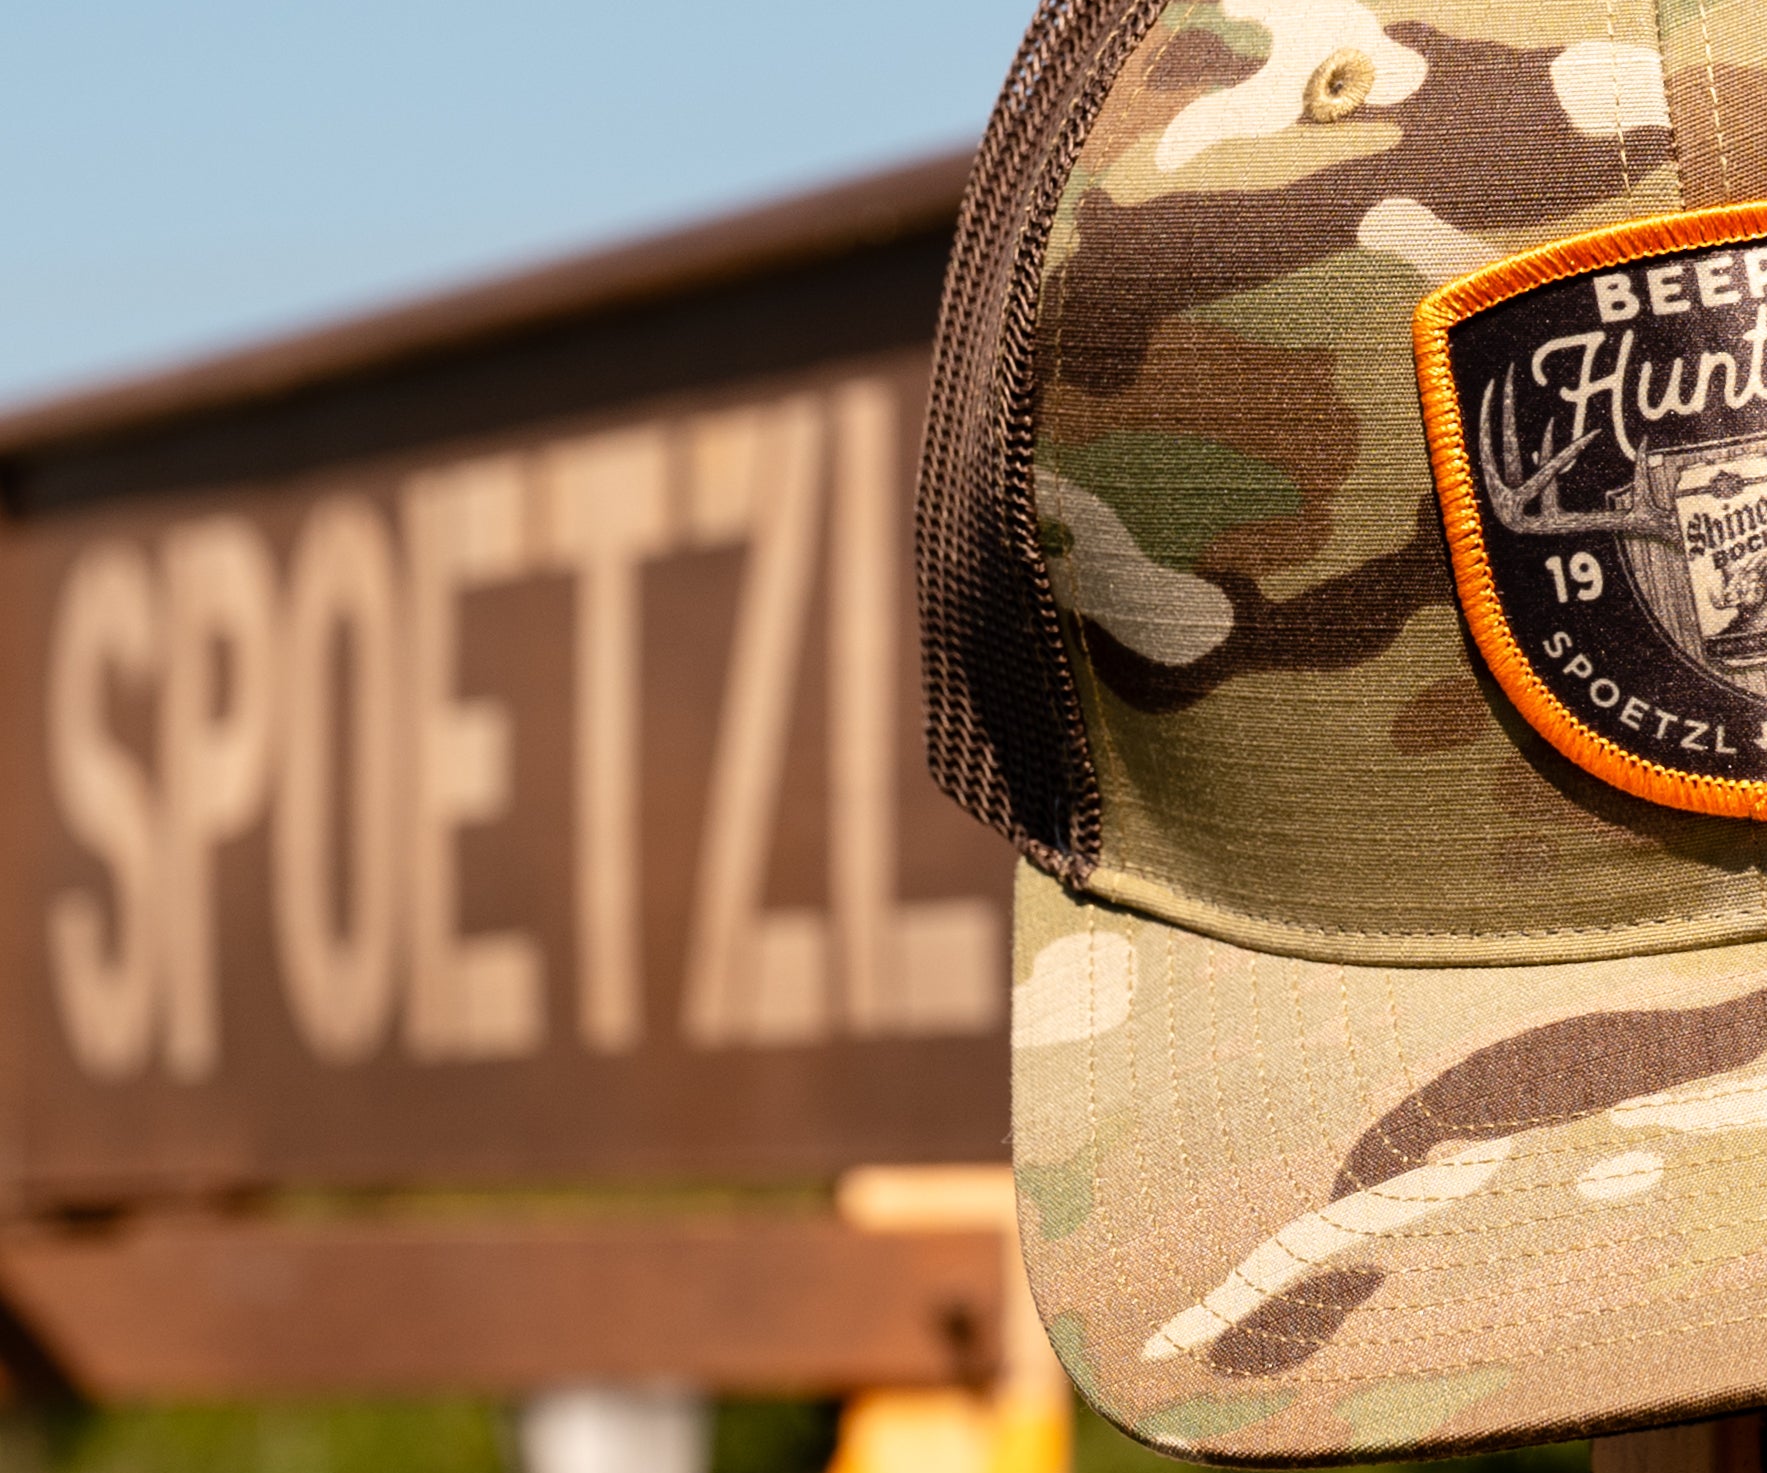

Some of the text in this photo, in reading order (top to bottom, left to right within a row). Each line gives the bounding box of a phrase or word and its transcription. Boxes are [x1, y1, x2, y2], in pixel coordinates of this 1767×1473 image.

[1544, 550, 1605, 604] 19
[46, 378, 1002, 1088] SPOETZL
[1542, 629, 1740, 756] SPOETZL
